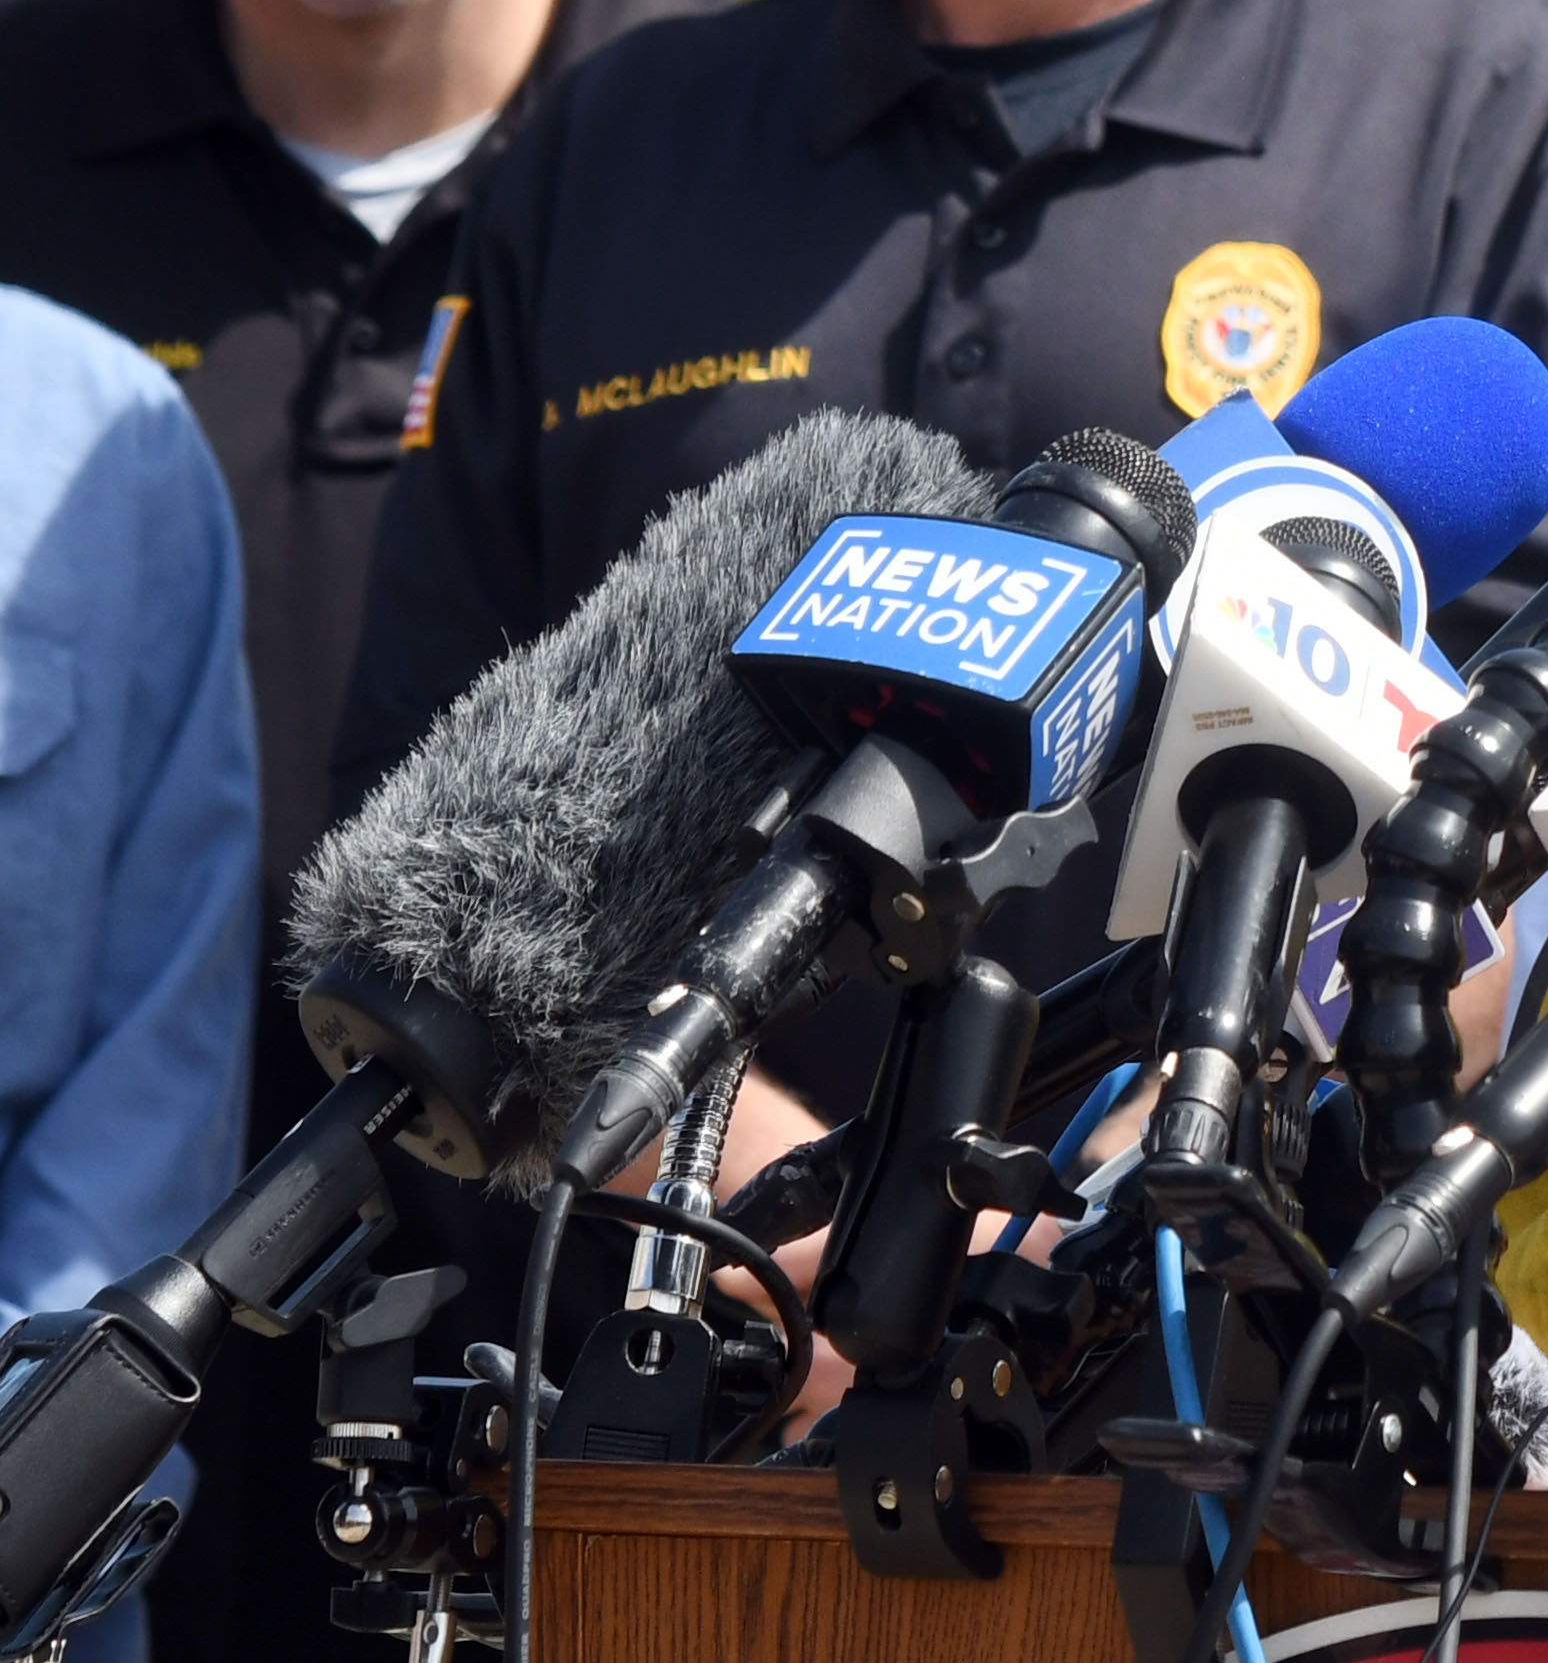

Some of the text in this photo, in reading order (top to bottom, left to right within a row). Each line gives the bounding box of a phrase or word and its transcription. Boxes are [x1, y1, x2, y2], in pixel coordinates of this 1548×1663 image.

[576, 344, 812, 419] MCLAUGHLIN
[820, 545, 1050, 617] NEWS
[790, 592, 1017, 659] NATION
[1267, 596, 1351, 697] 10
